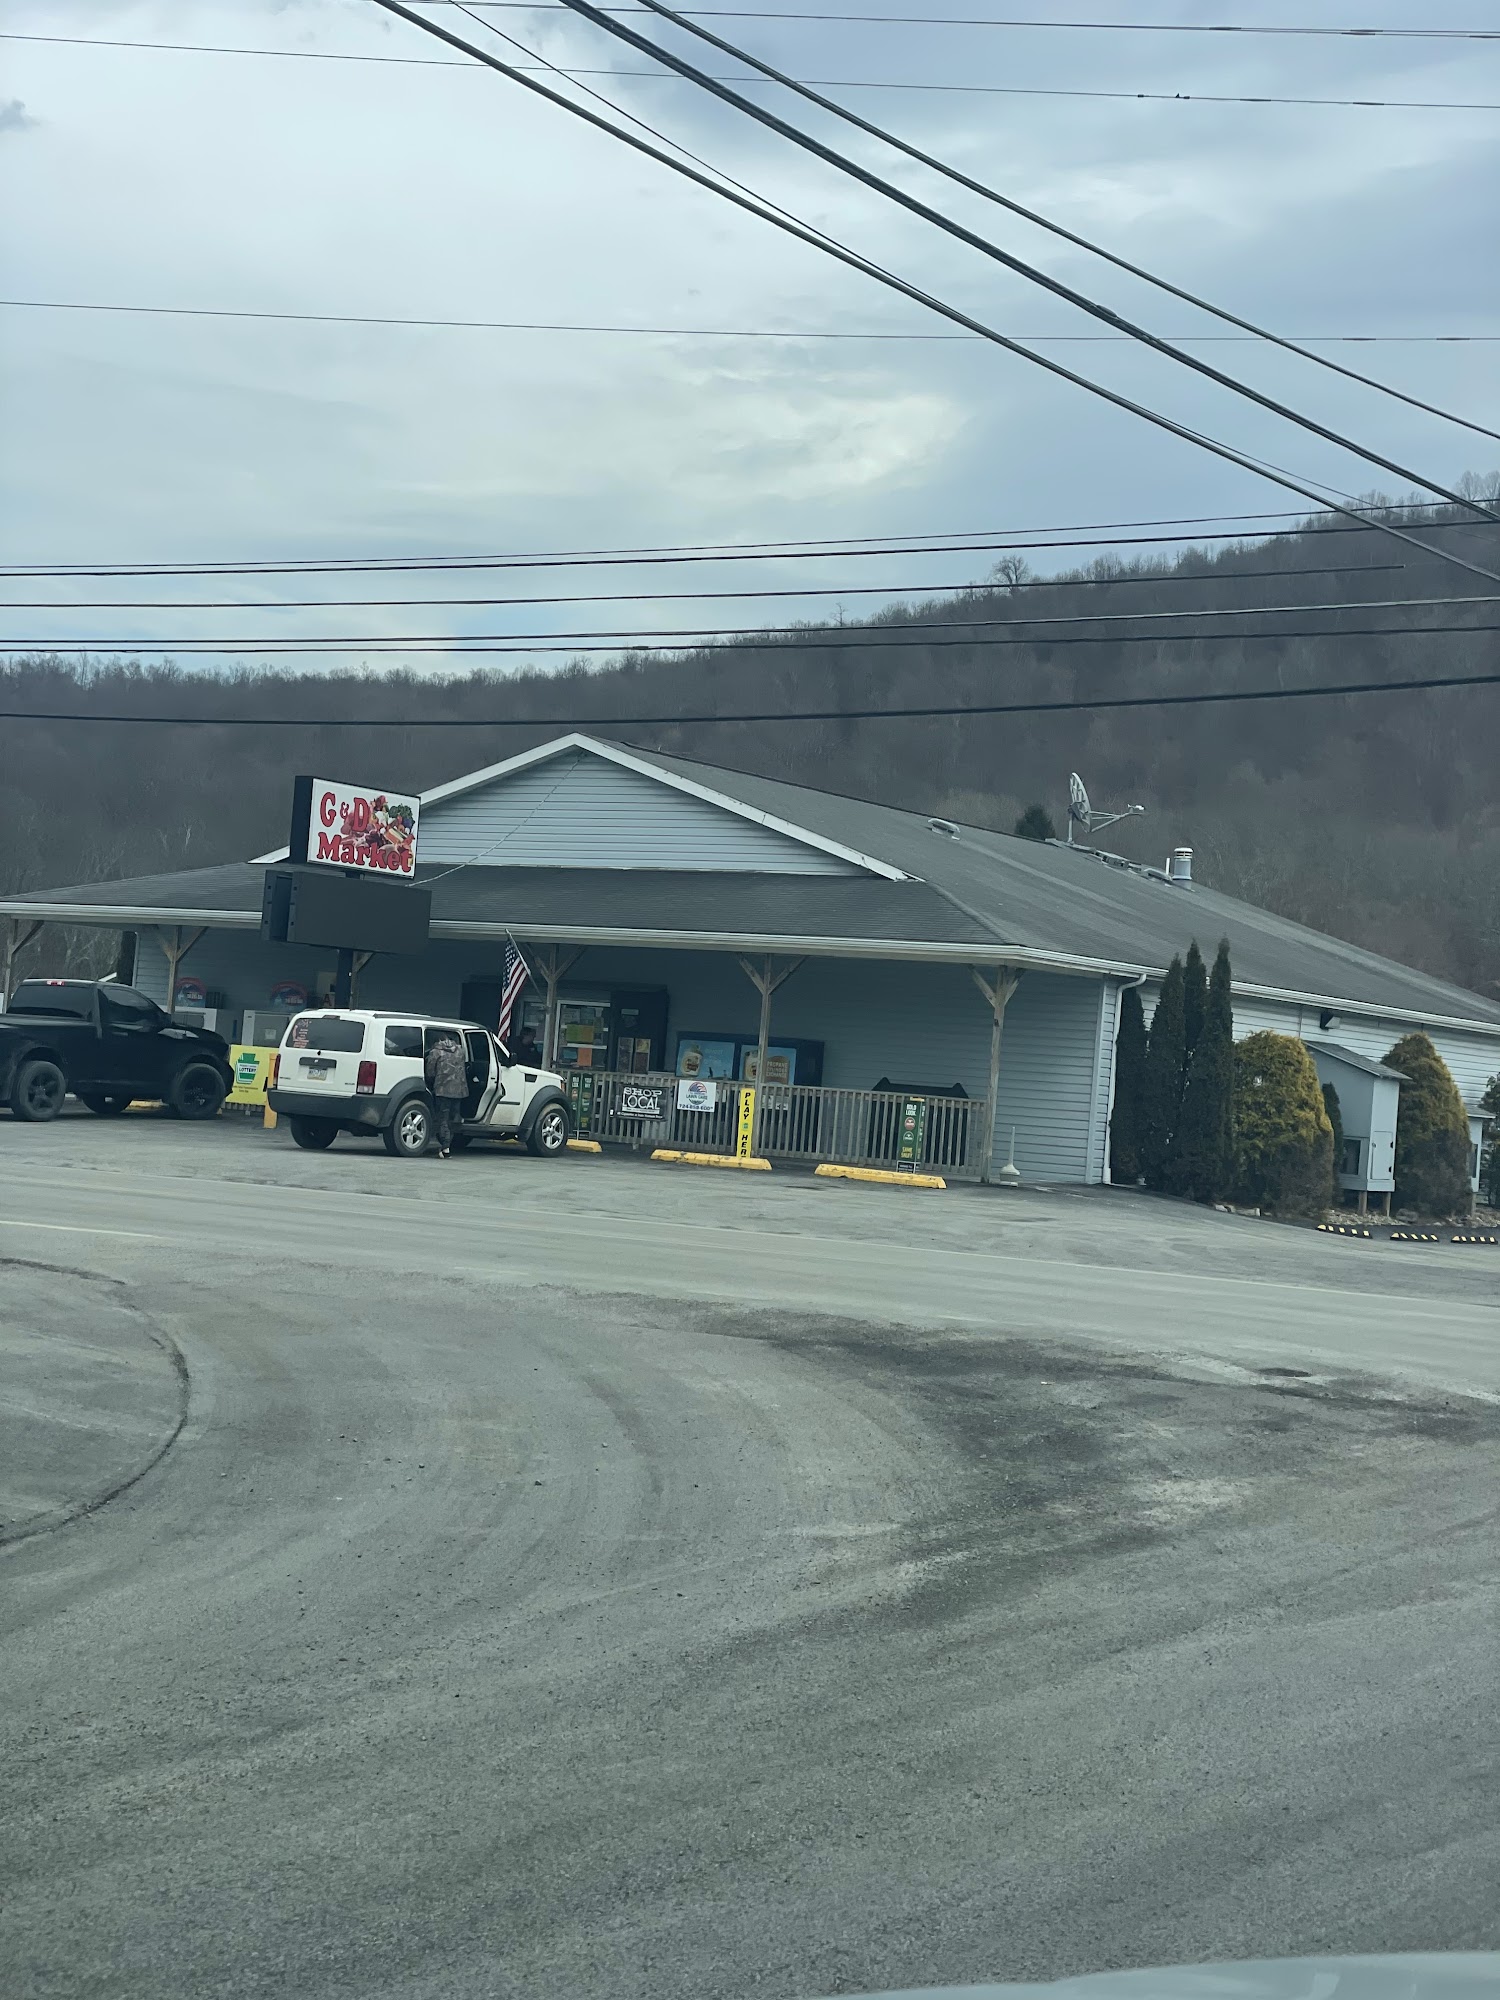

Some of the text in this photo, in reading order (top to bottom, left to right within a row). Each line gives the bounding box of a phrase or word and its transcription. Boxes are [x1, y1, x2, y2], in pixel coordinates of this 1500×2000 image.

[317, 832, 413, 873] Market
[622, 1094, 660, 1110] LOCAL
[624, 1087, 662, 1097] SHOP
[740, 1092, 751, 1158] PLAY HER
